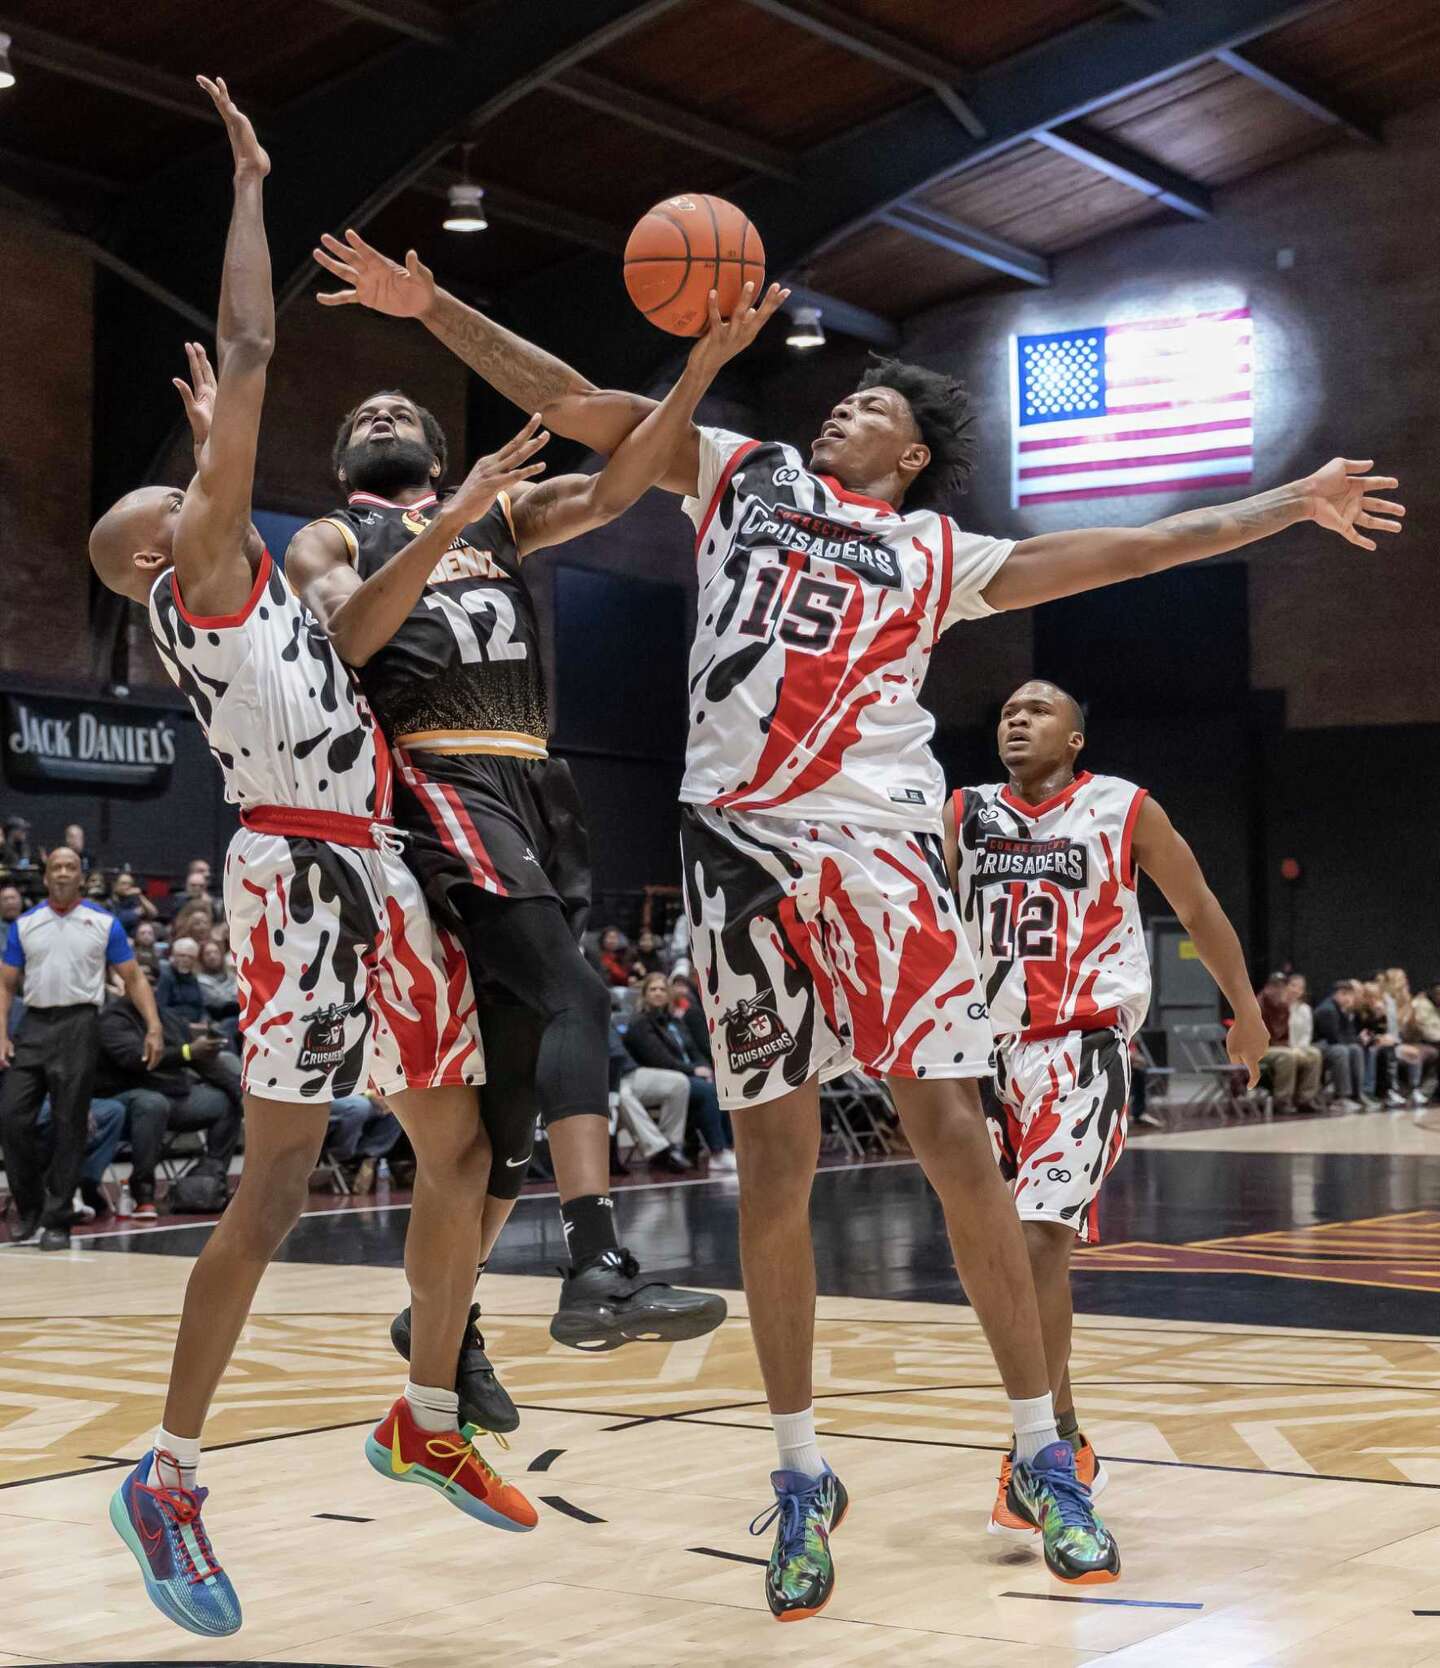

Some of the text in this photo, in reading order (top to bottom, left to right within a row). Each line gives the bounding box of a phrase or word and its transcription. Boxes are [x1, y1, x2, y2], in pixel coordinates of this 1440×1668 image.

[423, 588, 528, 664] 12
[738, 565, 856, 656] 15
[9, 705, 72, 758] JACK
[976, 848, 1083, 880] CRUSADERS
[989, 893, 1059, 961] 12
[730, 1031, 794, 1070] CRUSADERS
